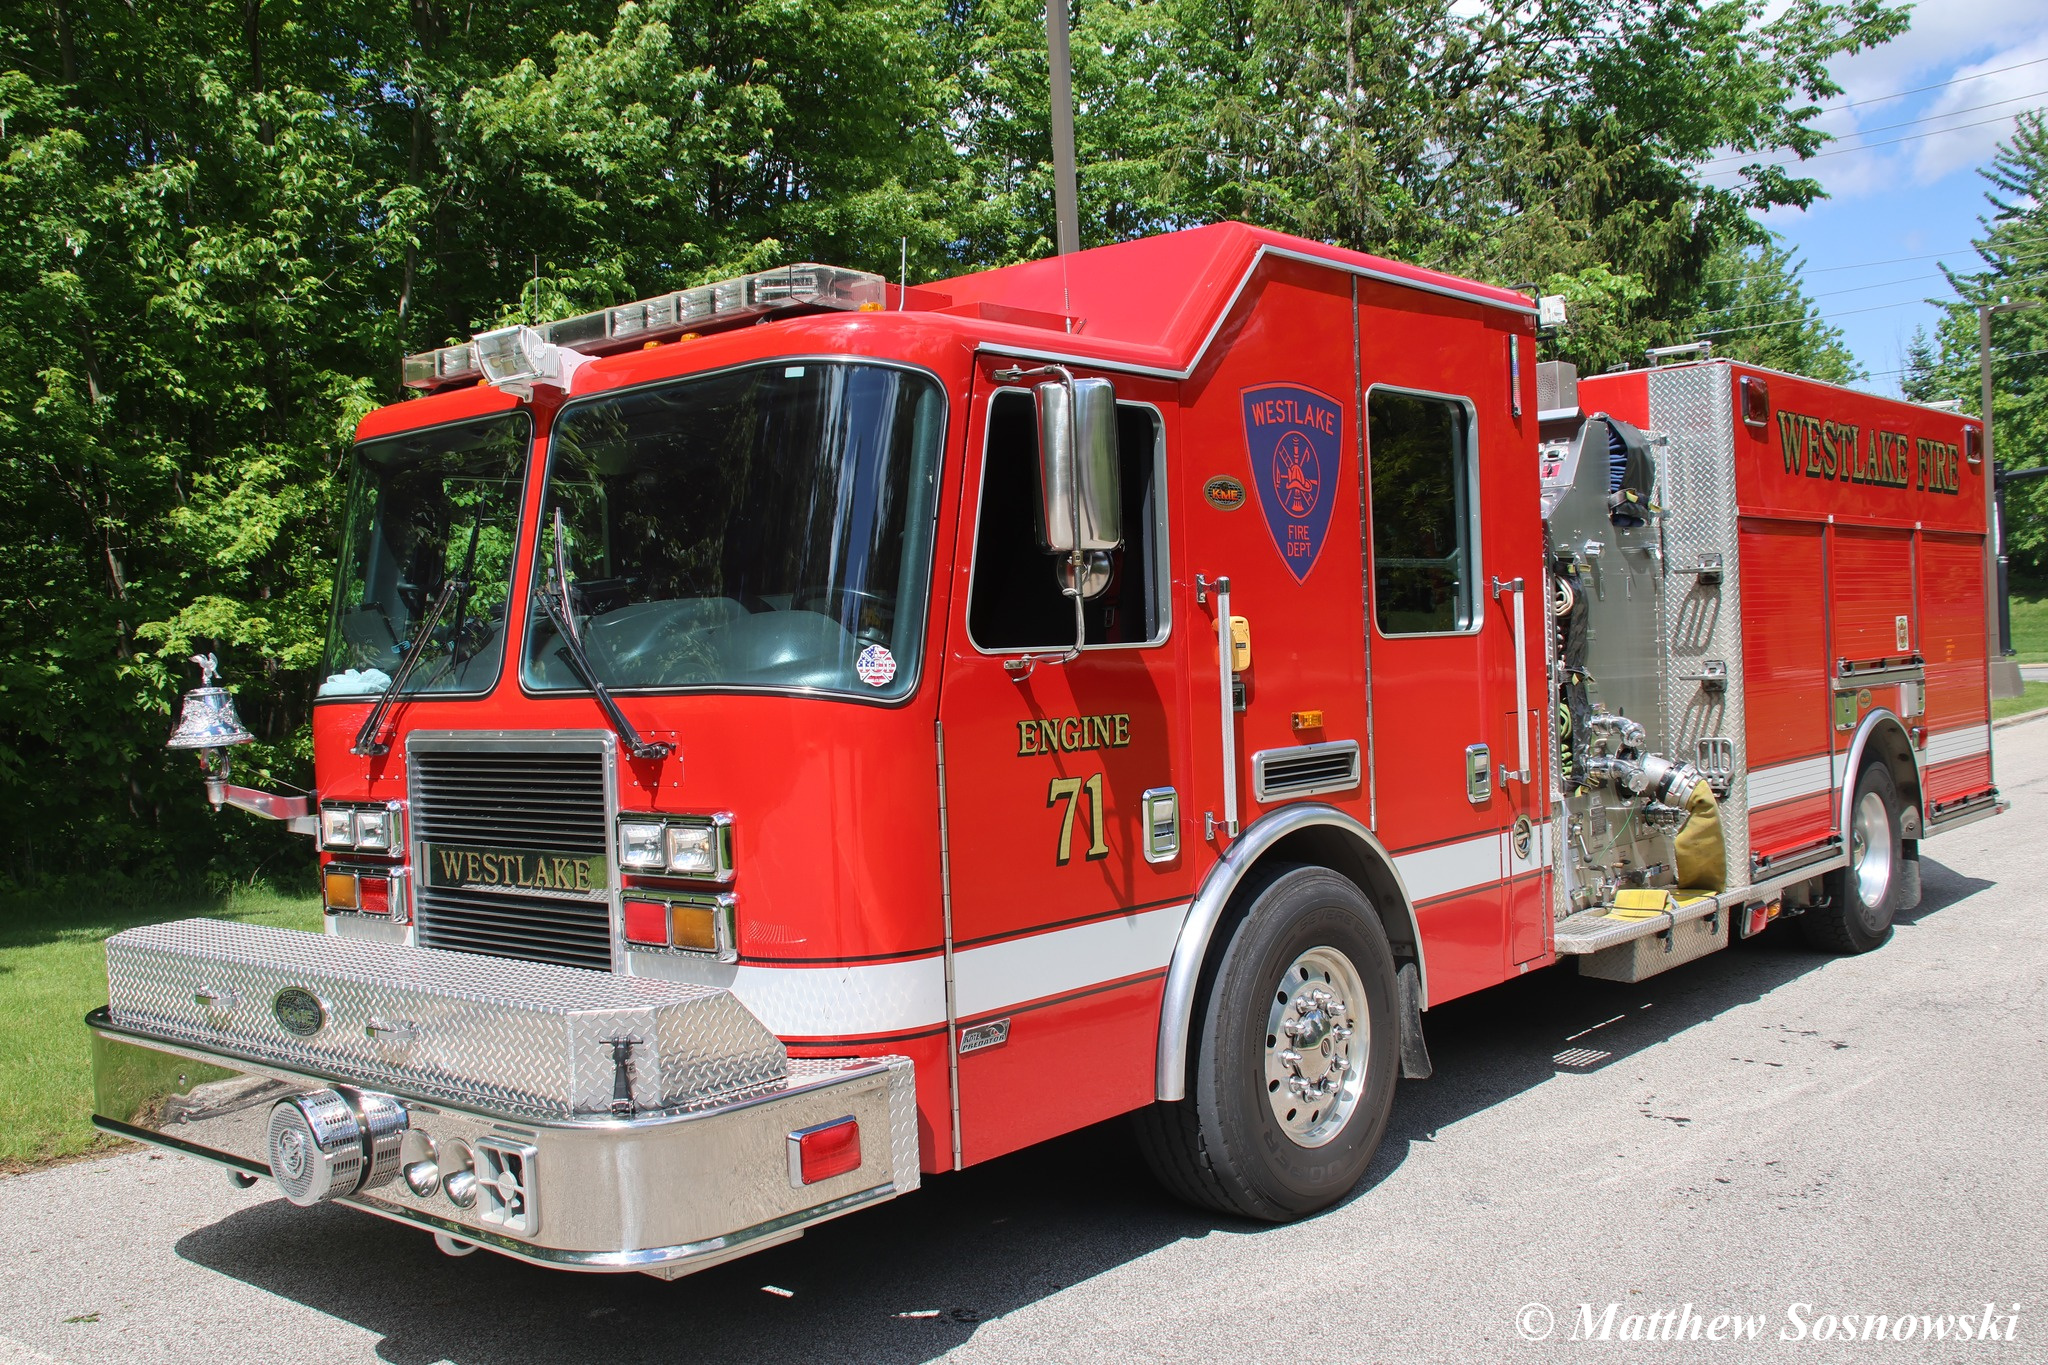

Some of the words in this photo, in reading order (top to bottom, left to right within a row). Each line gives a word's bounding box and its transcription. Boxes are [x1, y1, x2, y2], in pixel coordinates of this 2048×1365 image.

[1252, 400, 1335, 436] WESTLAKE
[1777, 410, 1909, 489] WESTLAKE
[1916, 437, 1959, 495] FIRE
[1211, 488, 1239, 501] KME
[1287, 524, 1310, 541] FIRE
[1287, 541, 1312, 558] DEPT.
[1017, 713, 1131, 757] ENGINE
[1046, 773, 1109, 867] 71
[439, 850, 592, 894] WESTLAKE
[962, 1034, 1006, 1051] PREDATOR
